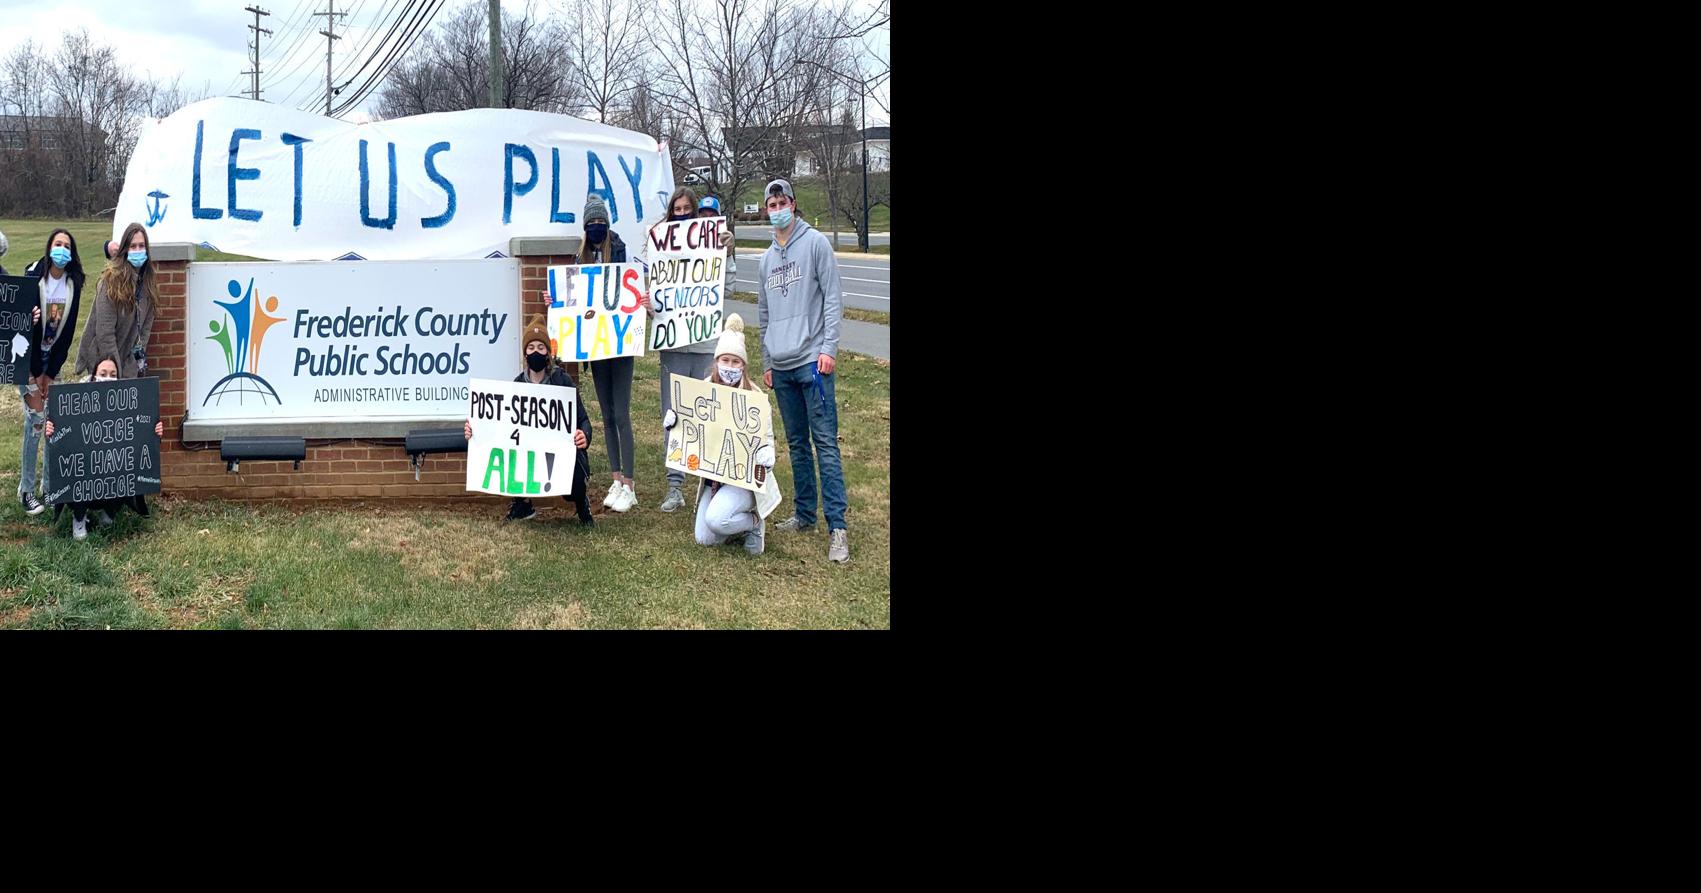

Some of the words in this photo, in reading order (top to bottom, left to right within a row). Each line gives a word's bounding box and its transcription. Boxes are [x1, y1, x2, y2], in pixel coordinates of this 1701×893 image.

[192, 120, 313, 230] LET
[359, 139, 456, 229] US
[503, 143, 643, 225] PLAY
[649, 223, 682, 252] WE
[687, 219, 725, 250] CARE
[649, 258, 691, 285] ABOUT
[692, 257, 722, 283] OUR
[654, 284, 720, 313] SENIORS
[293, 305, 409, 338] Frederick
[415, 306, 508, 344] County
[558, 314, 633, 359] PLAY
[653, 318, 676, 349] DO
[685, 310, 722, 344] YOU?
[293, 345, 369, 376] Public
[374, 343, 470, 375] Schools
[58, 391, 100, 416] HEAR
[106, 387, 138, 411] OUR
[314, 387, 410, 403] ADMINISTRATIVE
[415, 386, 469, 402] BUILDING
[674, 380, 721, 422] Let
[731, 391, 761, 434] Us
[471, 391, 573, 434] POST-SEASON
[81, 417, 135, 444] VOICE
[510, 428, 520, 446] 4
[58, 453, 85, 477] WE
[90, 446, 135, 474] HAVE
[140, 444, 152, 470] A
[680, 419, 762, 483] PLAY
[482, 447, 556, 494] ALL!
[73, 473, 136, 502] CHOICE
